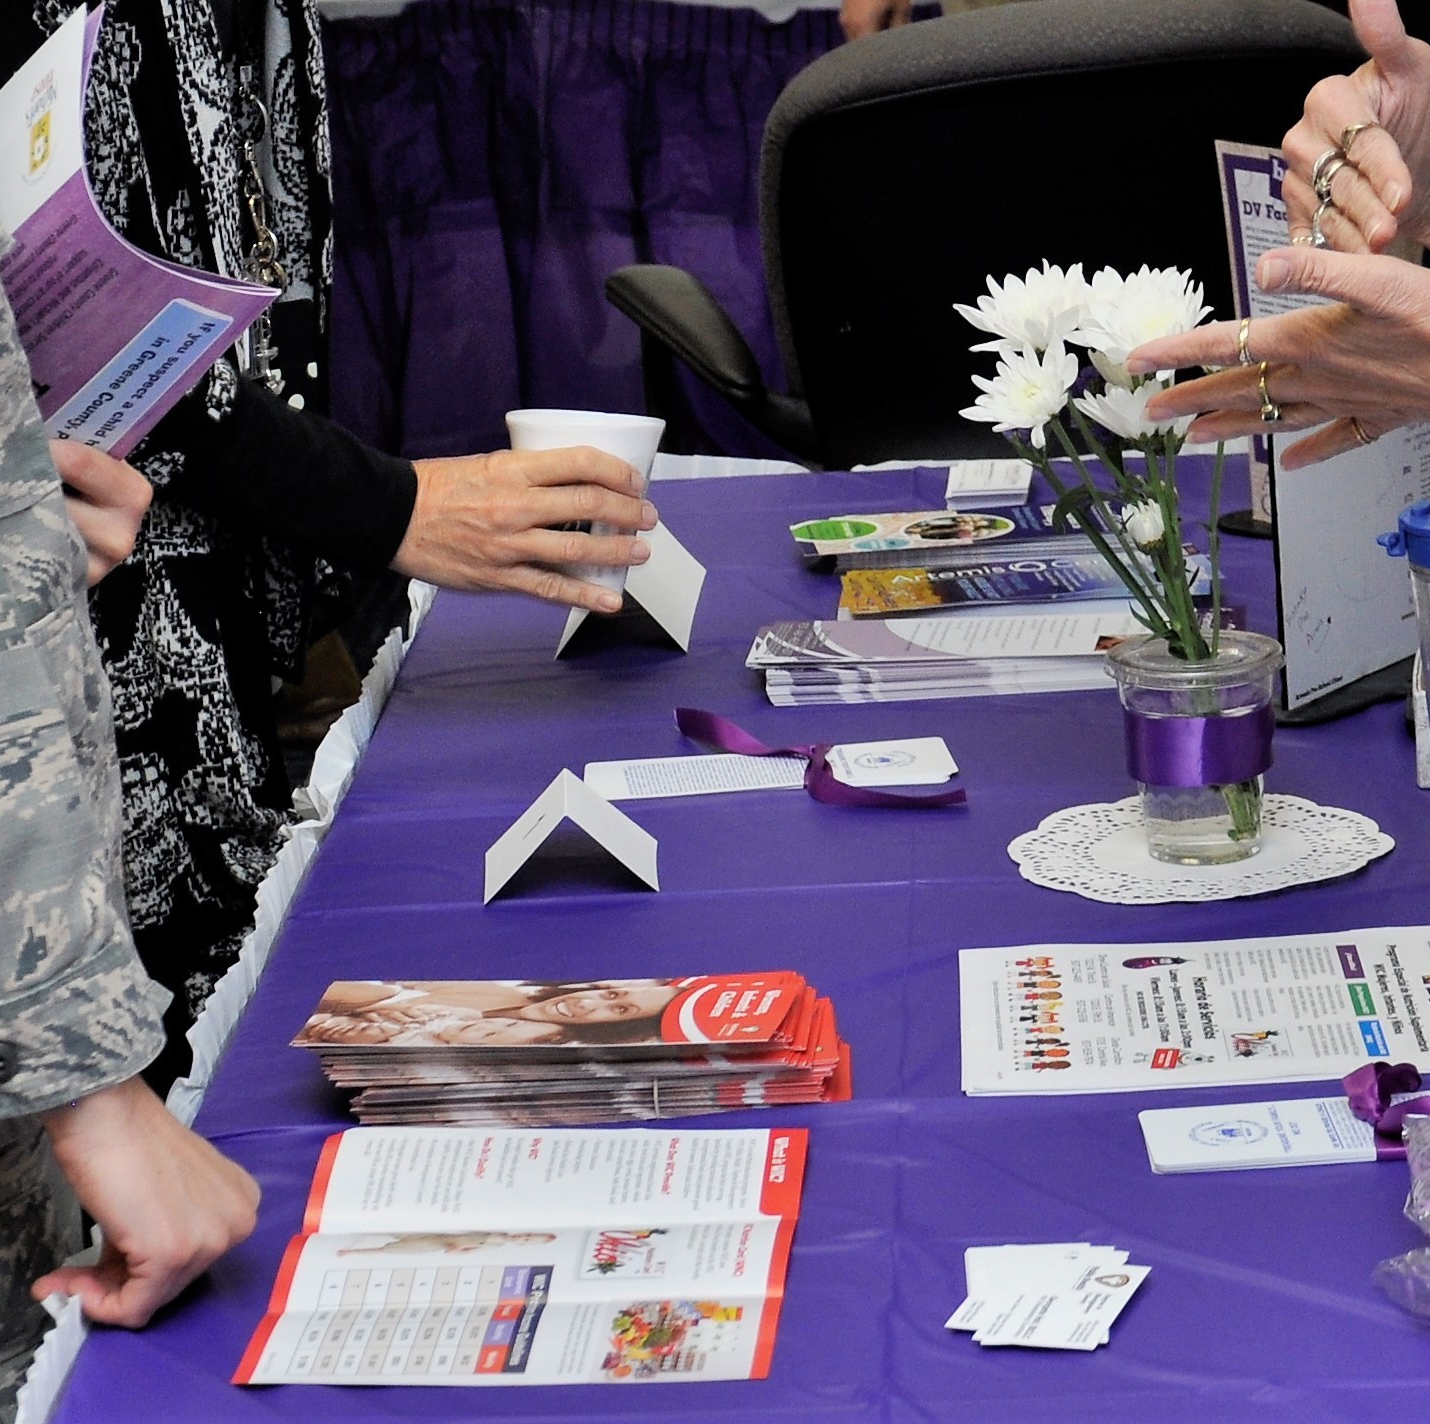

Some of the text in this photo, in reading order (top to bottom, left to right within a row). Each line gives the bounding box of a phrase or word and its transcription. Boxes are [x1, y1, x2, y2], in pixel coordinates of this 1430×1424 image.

[1242, 199, 1288, 222] DV Fac
[150, 336, 169, 348] in
[176, 332, 202, 354] you
[109, 350, 156, 390] Greene
[131, 356, 178, 399] suspect
[65, 391, 114, 430] County,
[94, 411, 124, 438] child
